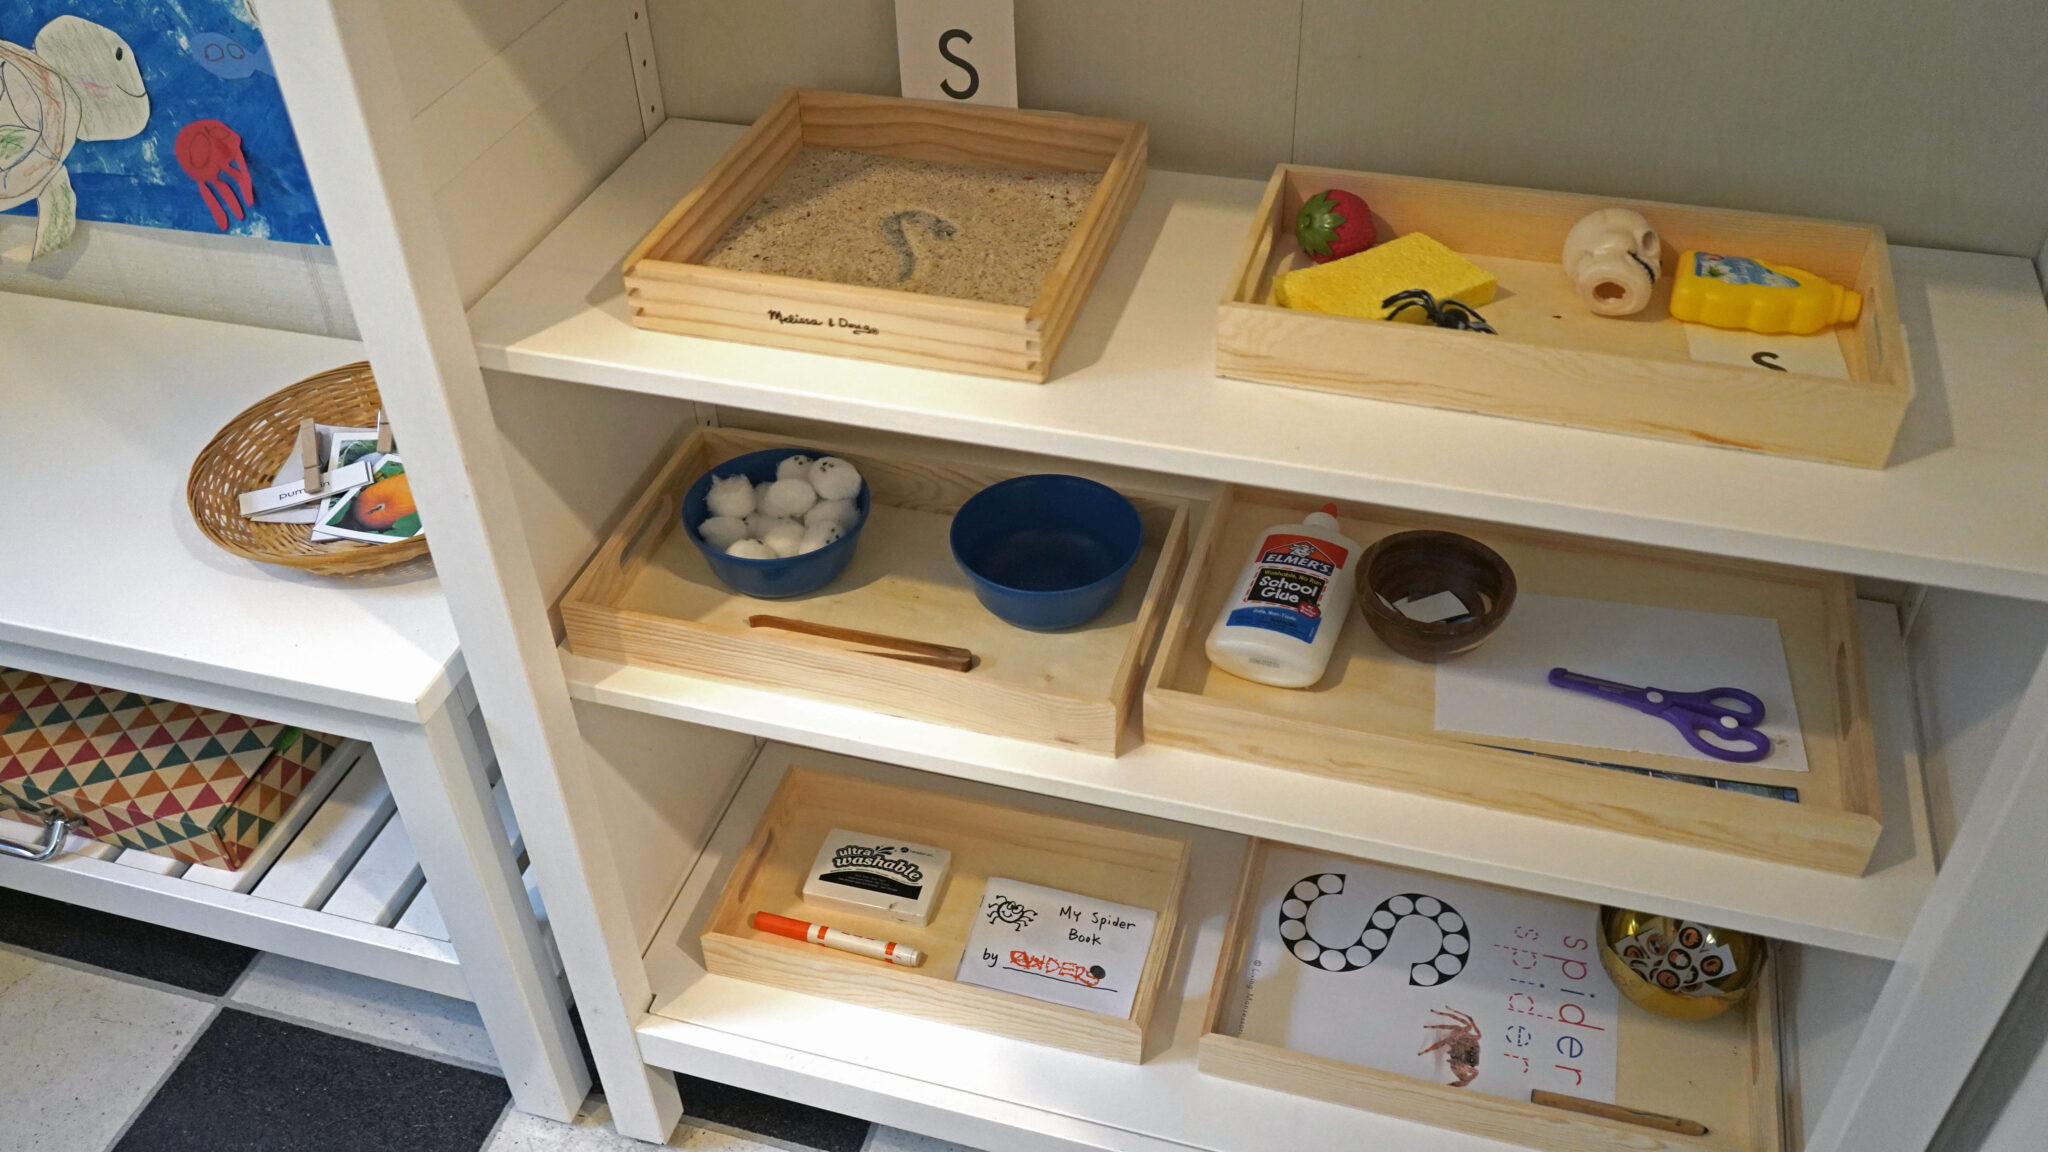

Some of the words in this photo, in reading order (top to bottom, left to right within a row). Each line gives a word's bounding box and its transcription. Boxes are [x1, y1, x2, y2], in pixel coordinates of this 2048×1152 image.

[767, 310, 823, 325] Melissa
[278, 481, 330, 501] pumin
[1265, 553, 1332, 574] ELMER'S
[1258, 575, 1319, 597] School
[1260, 587, 1300, 603] Glue
[837, 845, 873, 857] ultra
[833, 854, 921, 881] washable
[1059, 905, 1082, 923] My
[1091, 911, 1136, 931] Spider
[1068, 927, 1102, 946] Book
[982, 948, 998, 968] by
[1493, 926, 1553, 1074] spider
[1543, 935, 1605, 1086] spider
